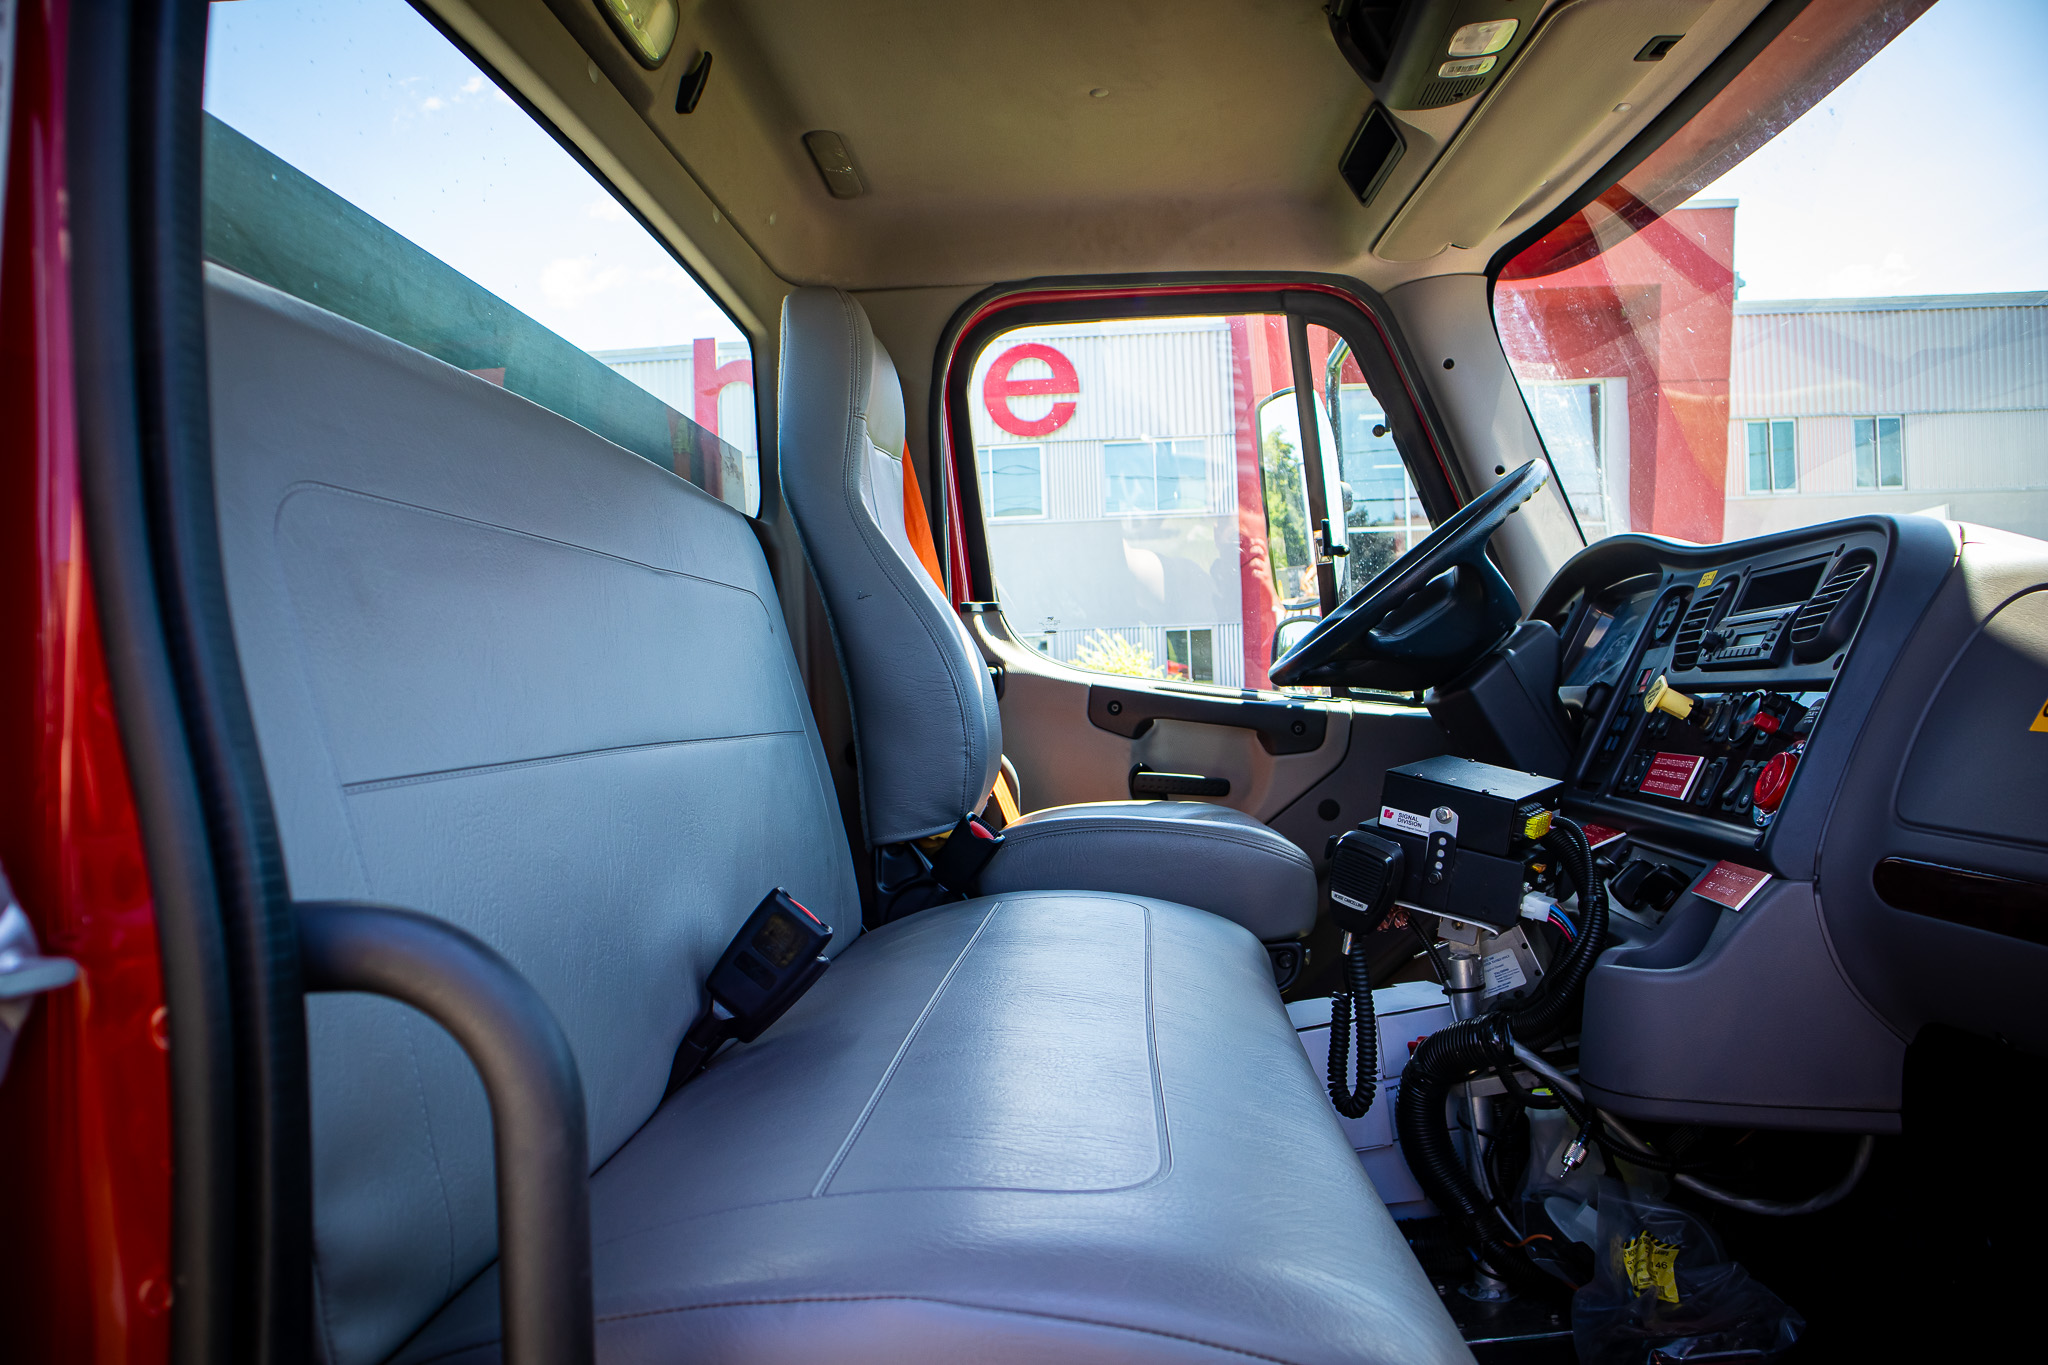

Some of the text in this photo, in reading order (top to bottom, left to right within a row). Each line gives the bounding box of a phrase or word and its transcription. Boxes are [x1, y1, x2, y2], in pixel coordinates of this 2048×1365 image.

[983, 343, 1080, 437] e
[1397, 817, 1422, 828] DIVISION
[1398, 812, 1419, 823] SIGNAL
